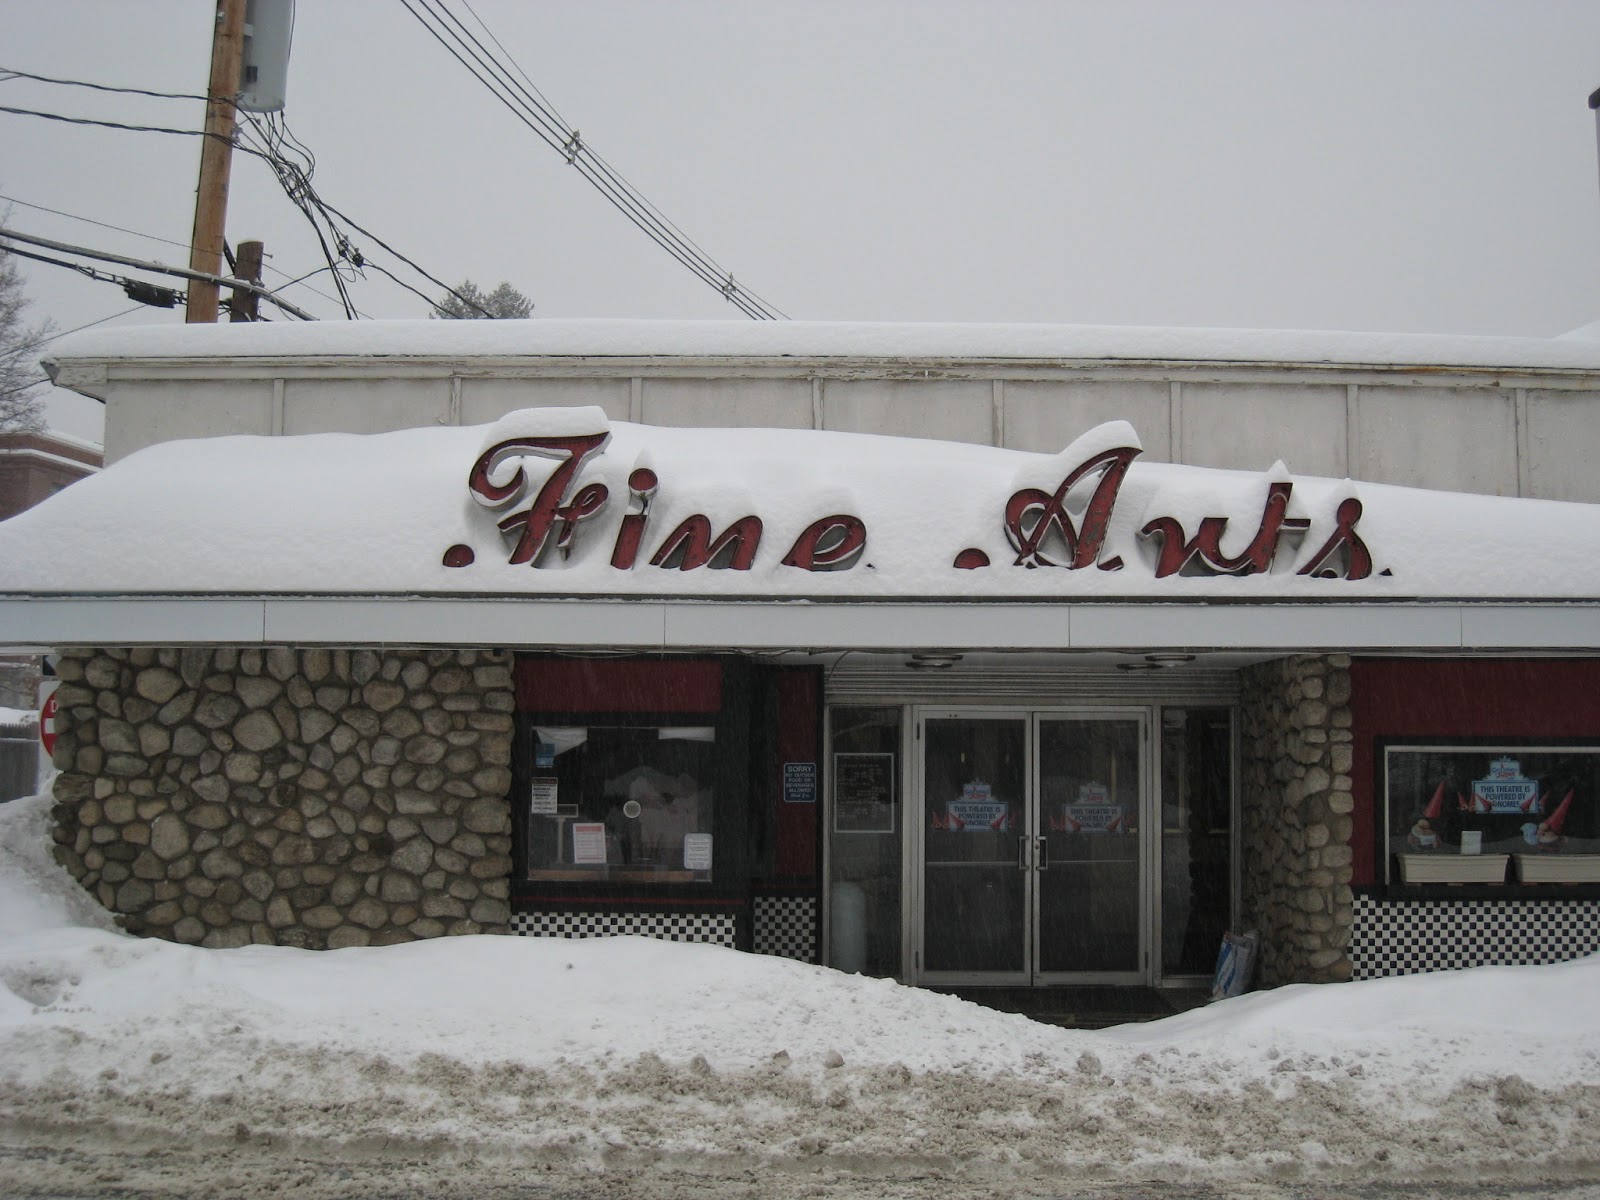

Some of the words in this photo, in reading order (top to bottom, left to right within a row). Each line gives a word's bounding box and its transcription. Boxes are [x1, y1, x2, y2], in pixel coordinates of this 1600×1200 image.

[468, 430, 875, 572] Fine
[1003, 446, 1392, 580] Arts
[1480, 785, 1495, 793] THIS
[1496, 785, 1523, 793] THEATRE
[1524, 785, 1531, 793] IS
[954, 805, 967, 813] THIS
[968, 805, 994, 813] THEATRE
[995, 805, 1001, 813] IS
